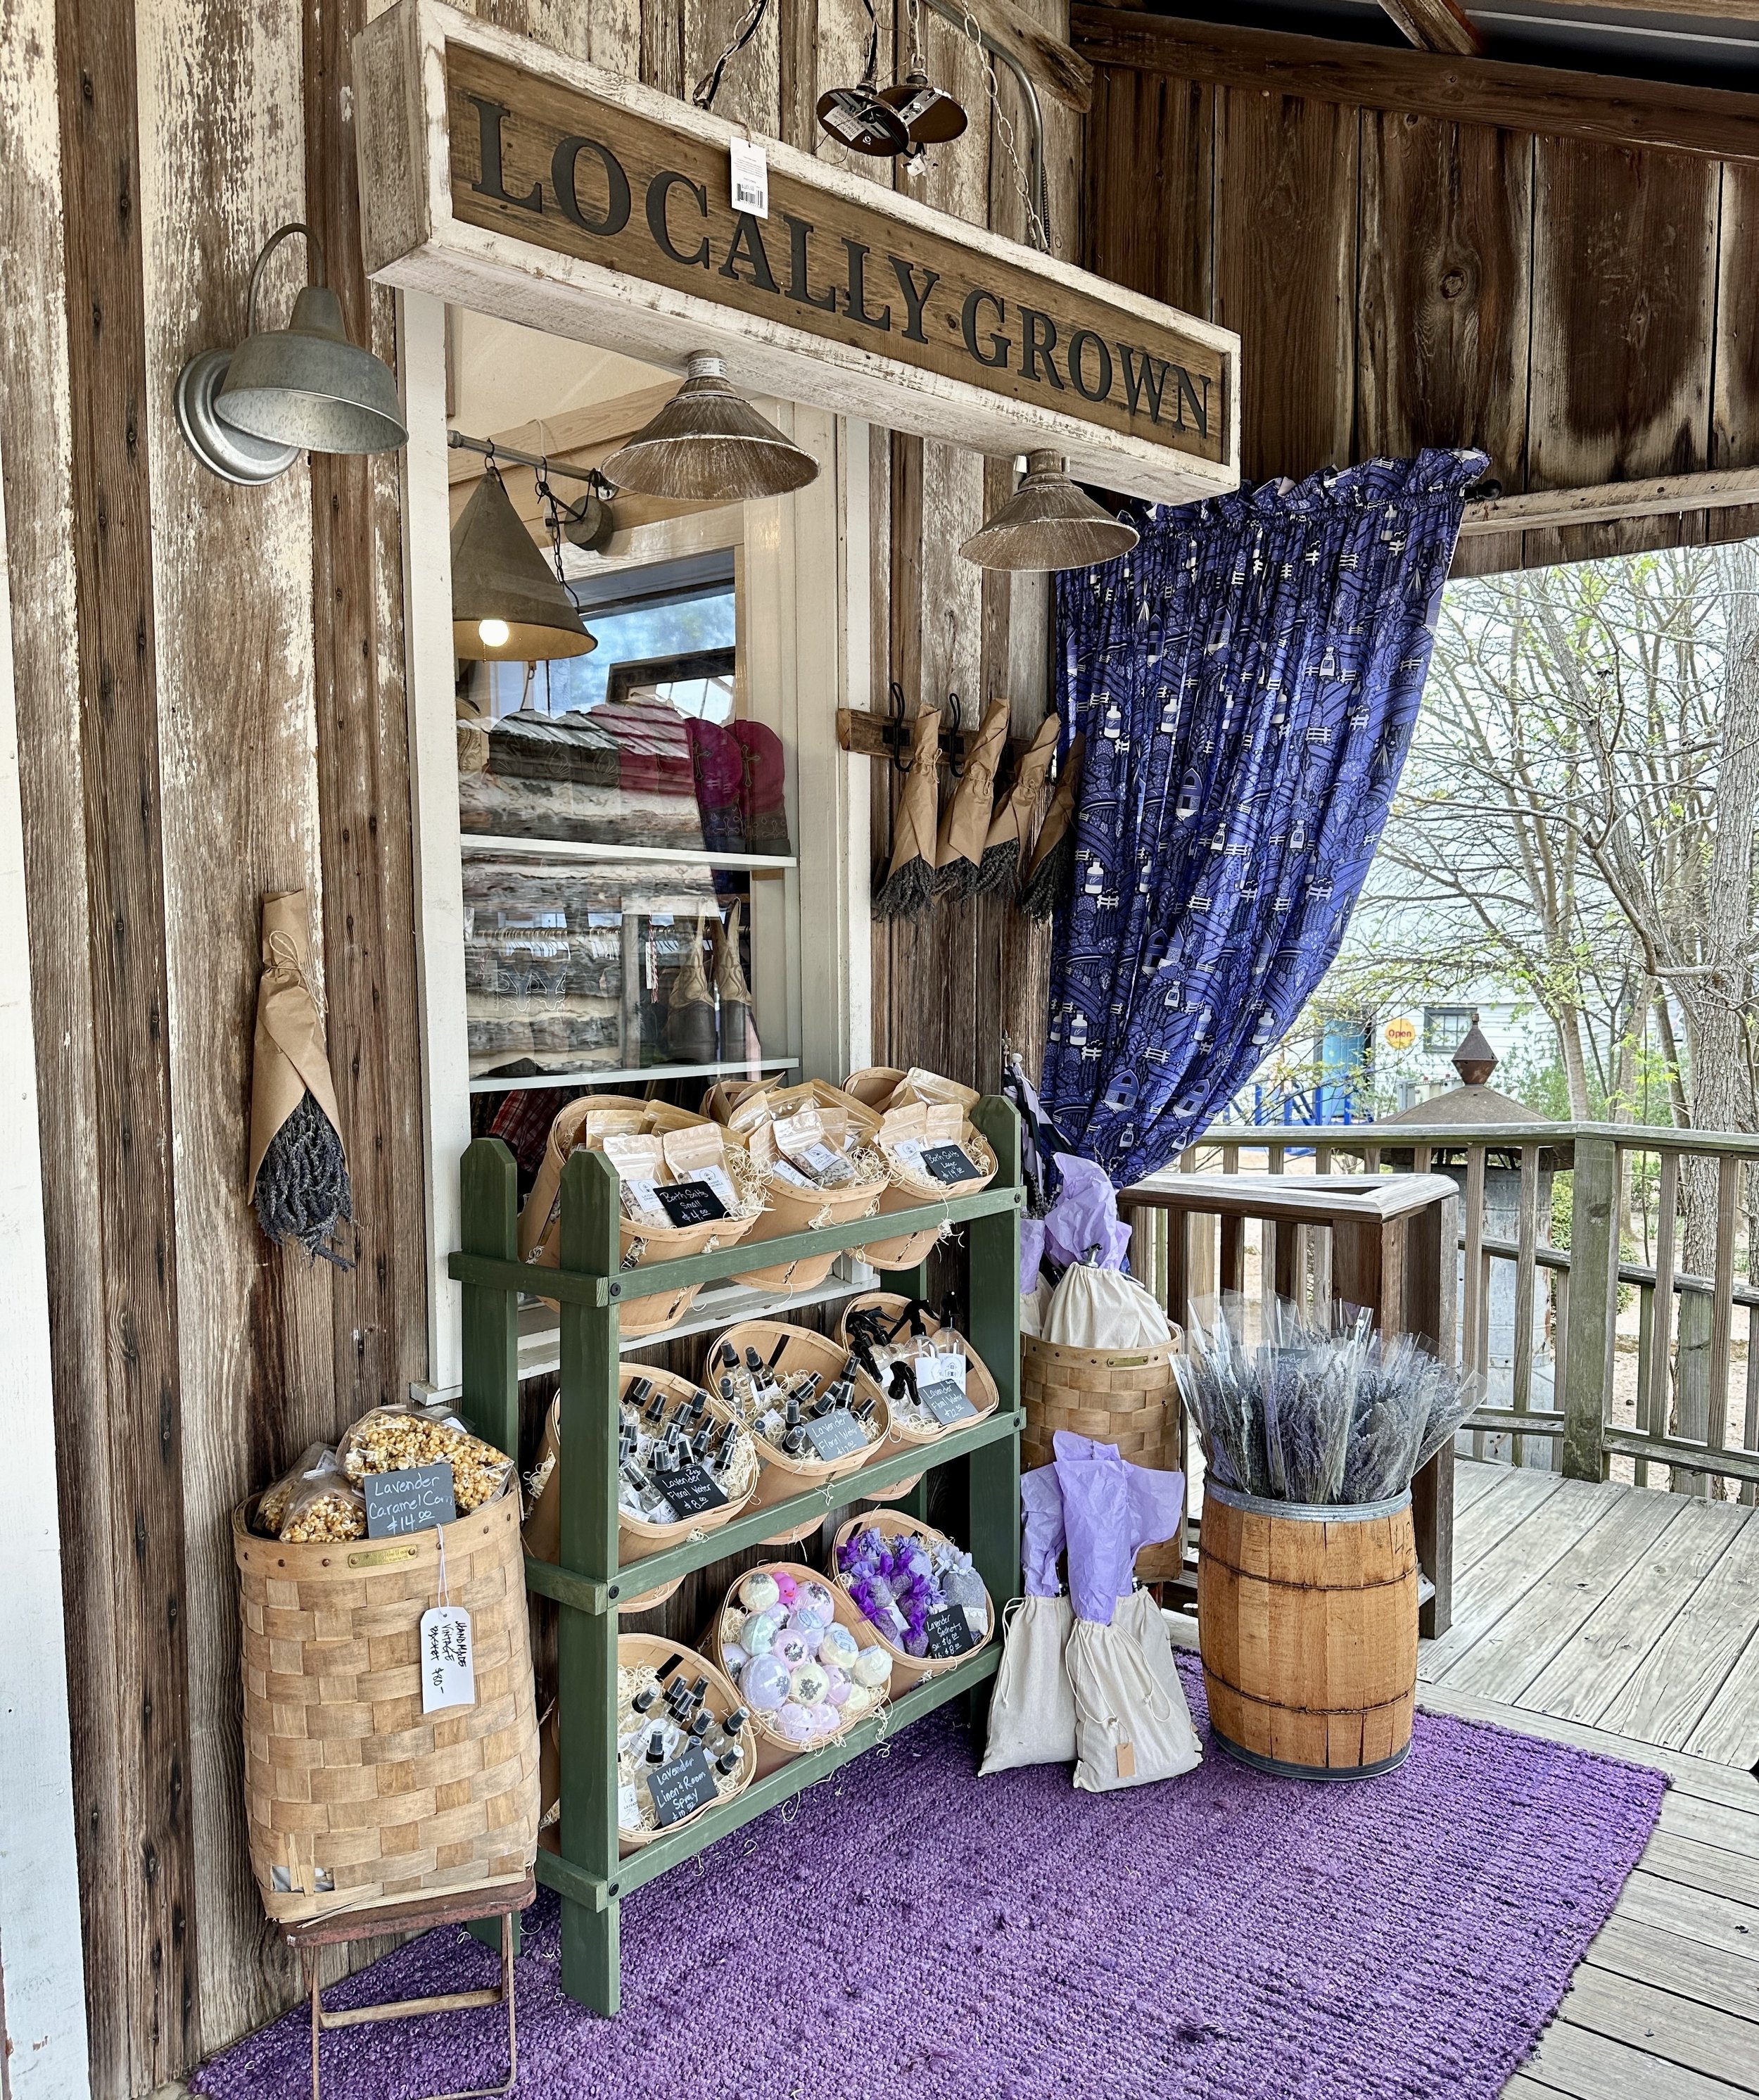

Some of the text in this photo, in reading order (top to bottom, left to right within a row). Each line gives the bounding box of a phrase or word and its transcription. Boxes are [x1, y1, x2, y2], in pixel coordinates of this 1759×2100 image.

[469, 96, 1211, 439] LOCALLY GROWN
[1388, 1029, 1412, 1039] Open
[924, 1153, 944, 1164] Bath
[942, 1150, 960, 1160] Salts
[659, 1189, 687, 1203] Bath
[685, 1189, 709, 1199] Salts
[680, 1199, 702, 1209] Small
[922, 1382, 952, 1400] Lavender
[931, 1393, 963, 1411] Floral Water
[811, 1415, 846, 1438] Lavender
[818, 1426, 858, 1453] Floral Water
[375, 1472, 440, 1496] Lavender
[661, 1472, 701, 1488] Lavender
[666, 1484, 712, 1500] Floral Water
[369, 1490, 452, 1519] Caramel Corn
[386, 1510, 436, 1535] $14.00
[926, 1614, 951, 1631] Lavender
[441, 1624, 455, 1662] VINTAGE
[656, 1757, 694, 1785] Lavender
[656, 1788, 680, 1809] Linen
[682, 1771, 706, 1790] Room
[672, 1788, 699, 1810] Spray
